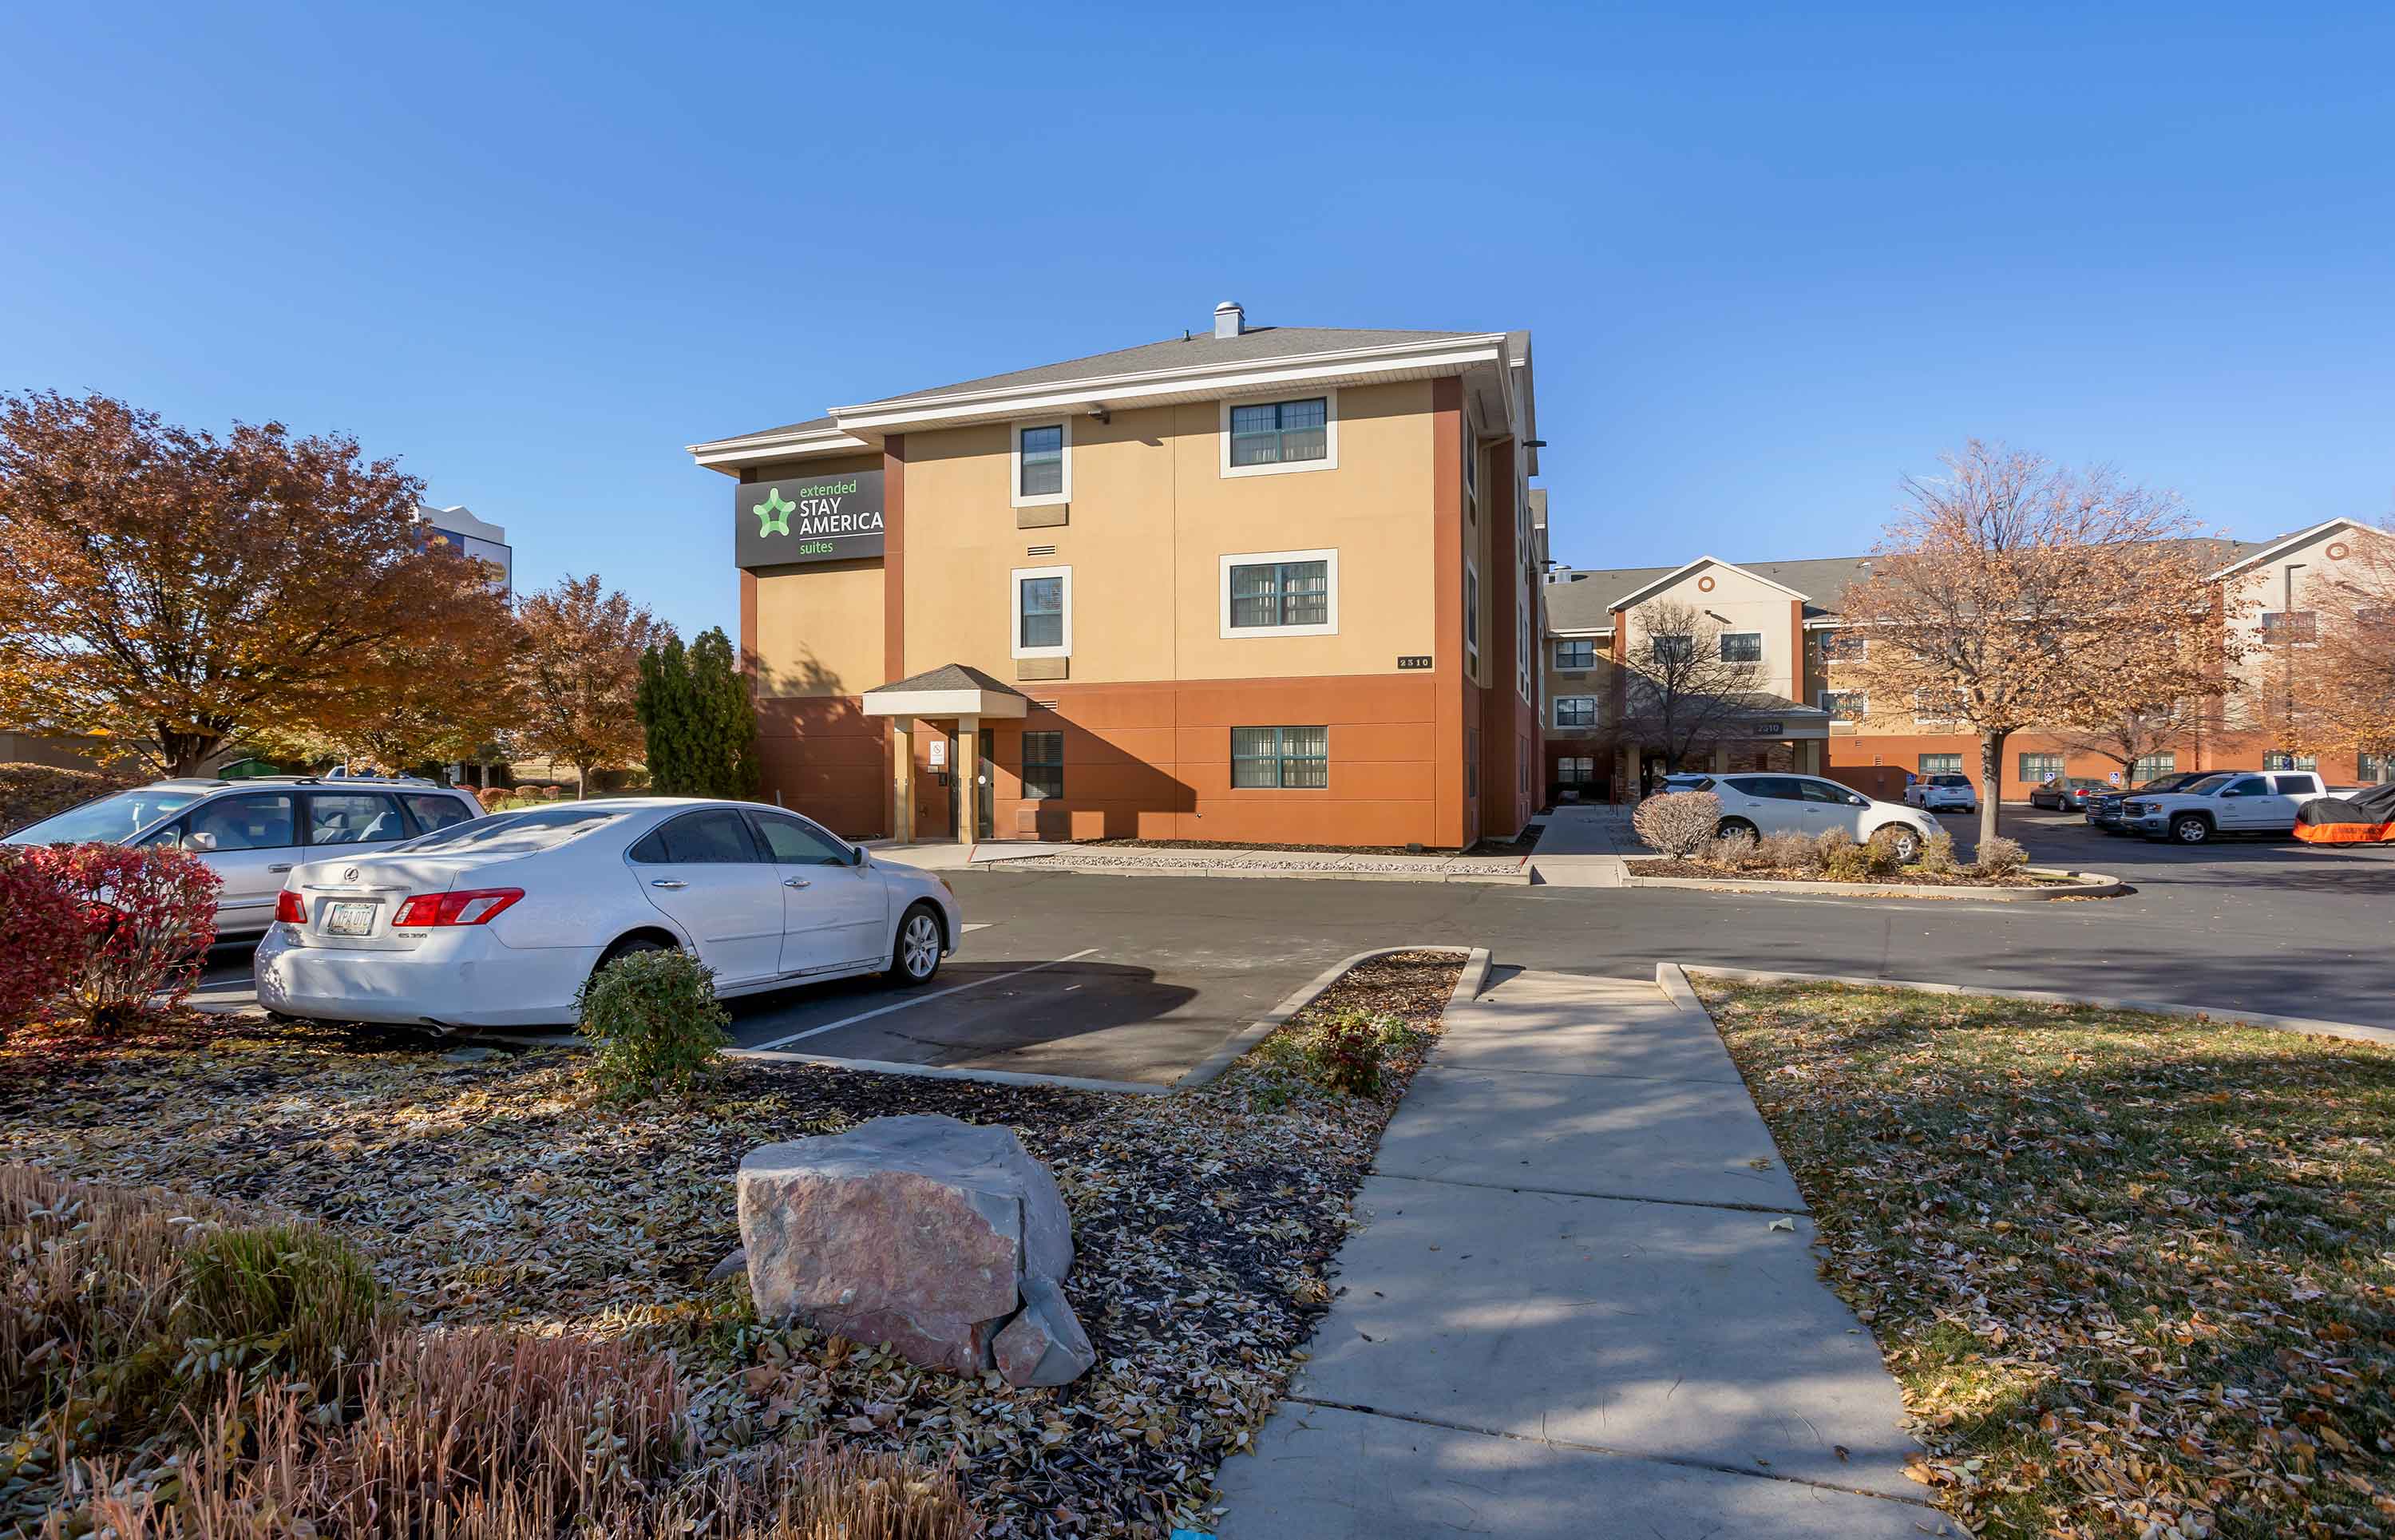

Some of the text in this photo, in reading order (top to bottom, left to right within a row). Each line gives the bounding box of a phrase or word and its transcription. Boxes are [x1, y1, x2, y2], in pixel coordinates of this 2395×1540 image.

[800, 480, 856, 498] extended
[800, 497, 841, 517] STAY
[800, 512, 884, 535] AMERICA
[800, 541, 833, 555] suites
